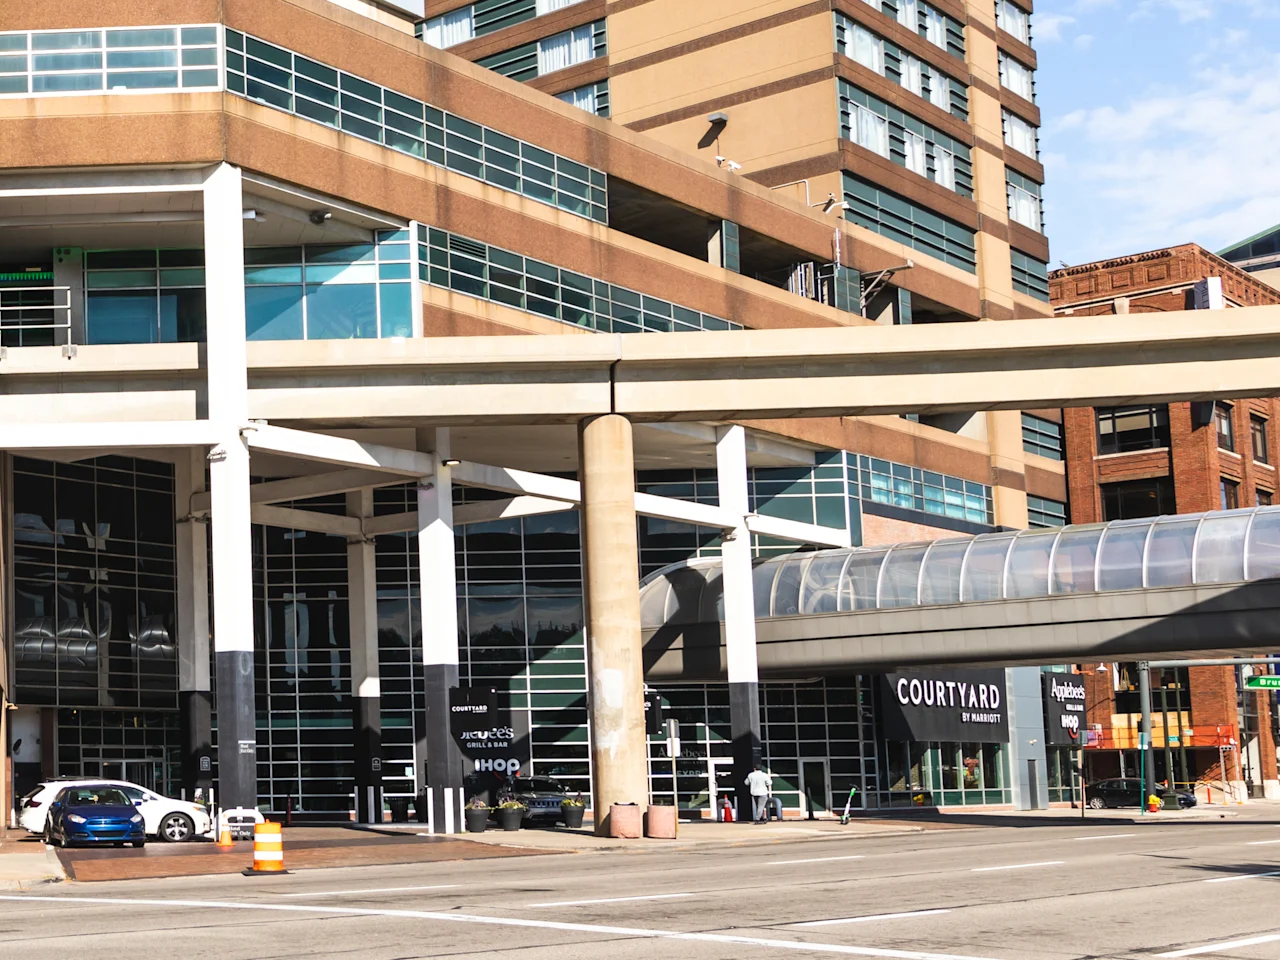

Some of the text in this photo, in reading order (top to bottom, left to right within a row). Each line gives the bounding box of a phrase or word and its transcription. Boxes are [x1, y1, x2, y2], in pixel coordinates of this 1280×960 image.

[897, 677, 1000, 709] COURTYARD
[962, 711, 1001, 723] BY MARRIOTT
